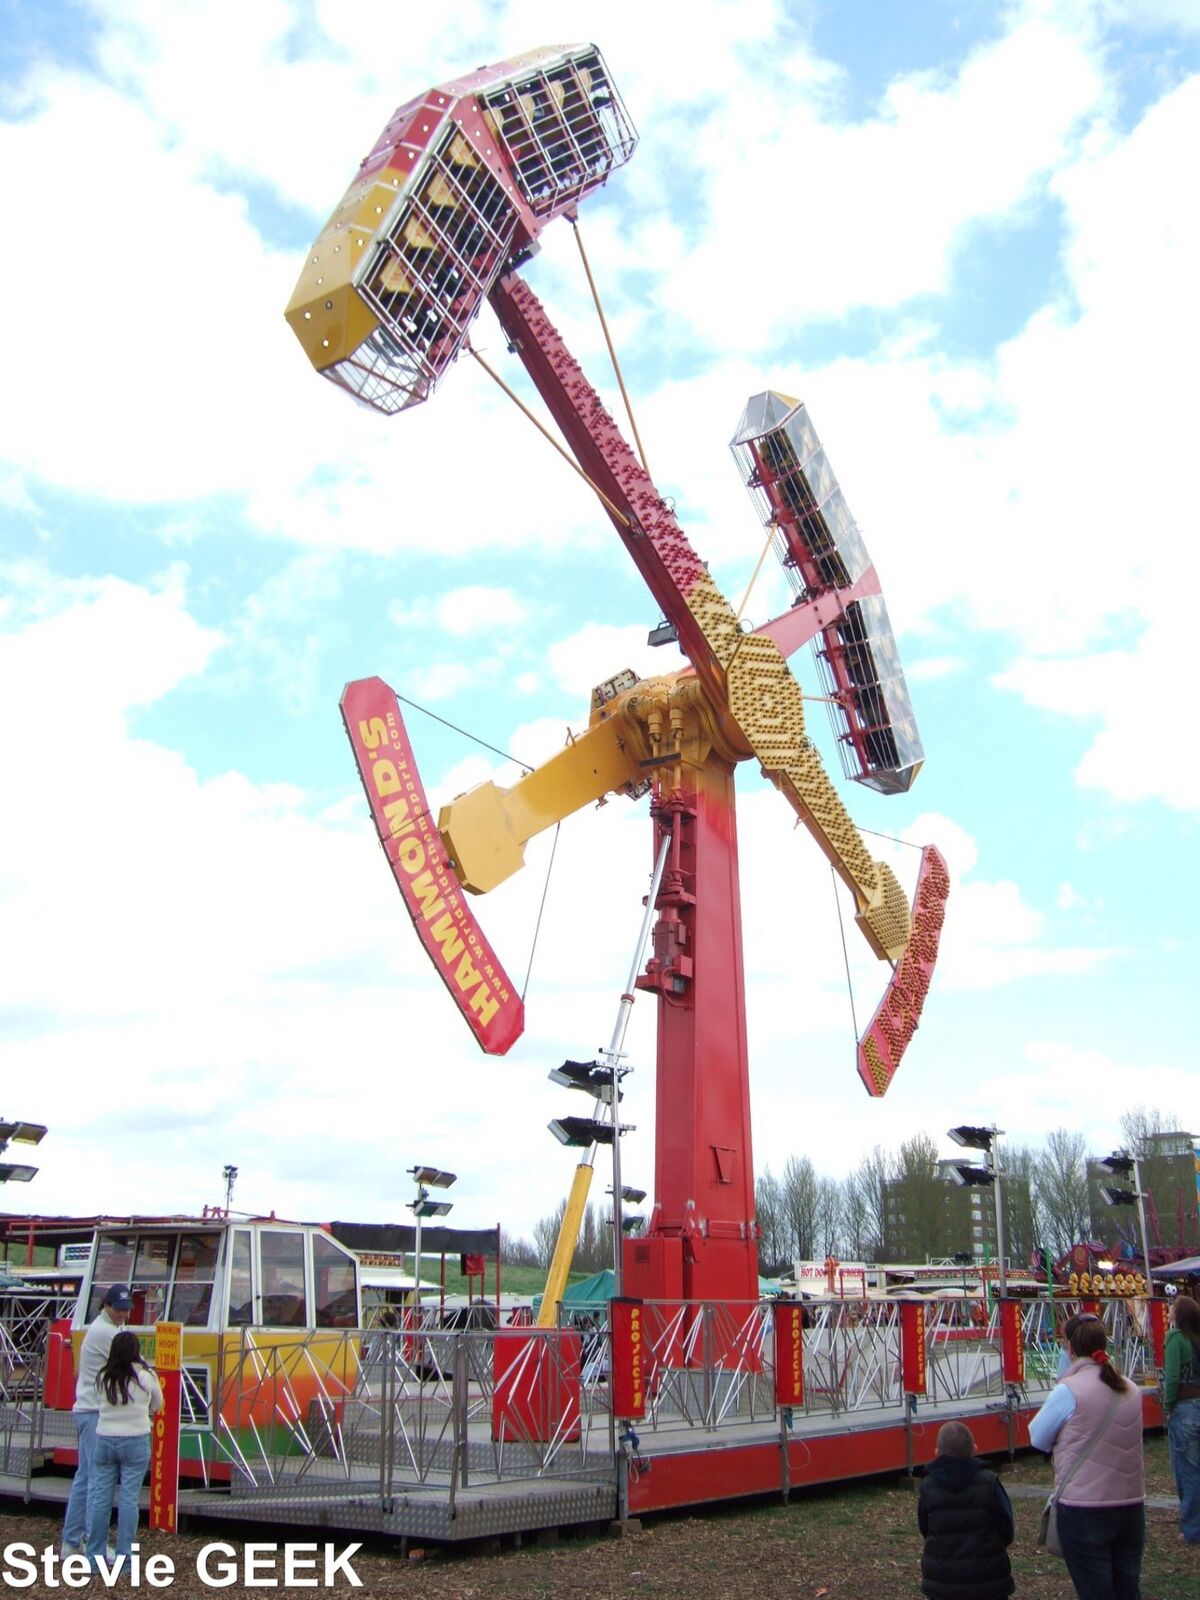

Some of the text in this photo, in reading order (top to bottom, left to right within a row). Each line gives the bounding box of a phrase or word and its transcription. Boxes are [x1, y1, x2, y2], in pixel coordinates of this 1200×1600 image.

[359, 715, 500, 1028] HAMMOND'S
[801, 1267, 813, 1278] HOT
[630, 1308, 641, 1390] PROJECT
[792, 1308, 800, 1380] PROJECT
[916, 1307, 924, 1372] PROJECT
